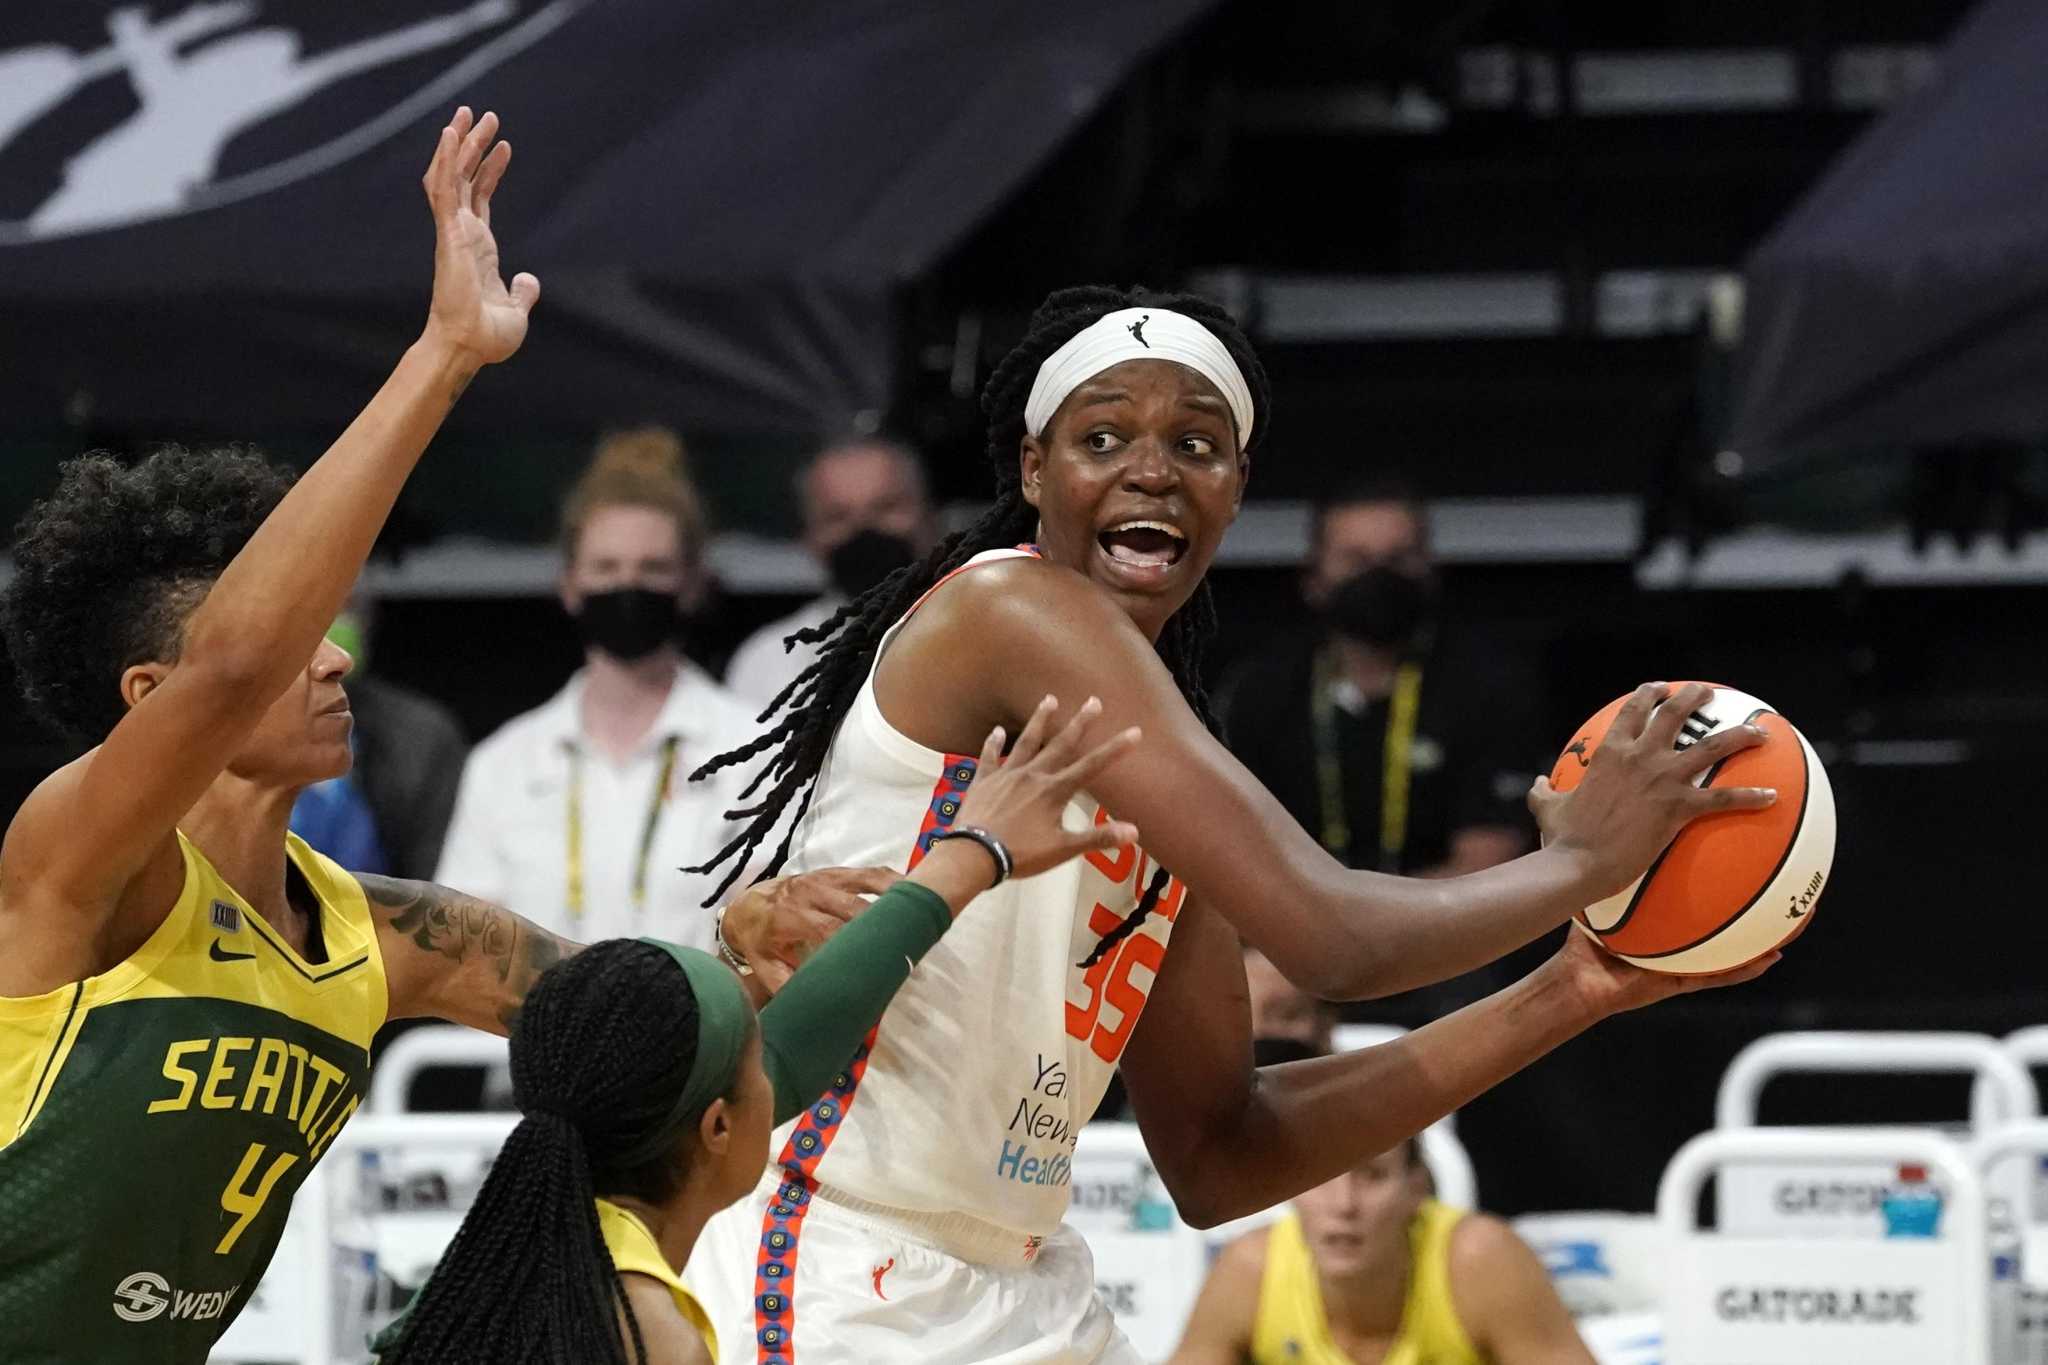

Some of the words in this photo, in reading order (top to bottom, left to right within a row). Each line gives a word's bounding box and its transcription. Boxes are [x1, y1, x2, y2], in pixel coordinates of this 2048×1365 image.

[1033, 1053, 1068, 1099] Ya
[214, 1142, 299, 1255] 4
[1715, 1287, 1922, 1325] GATORADE
